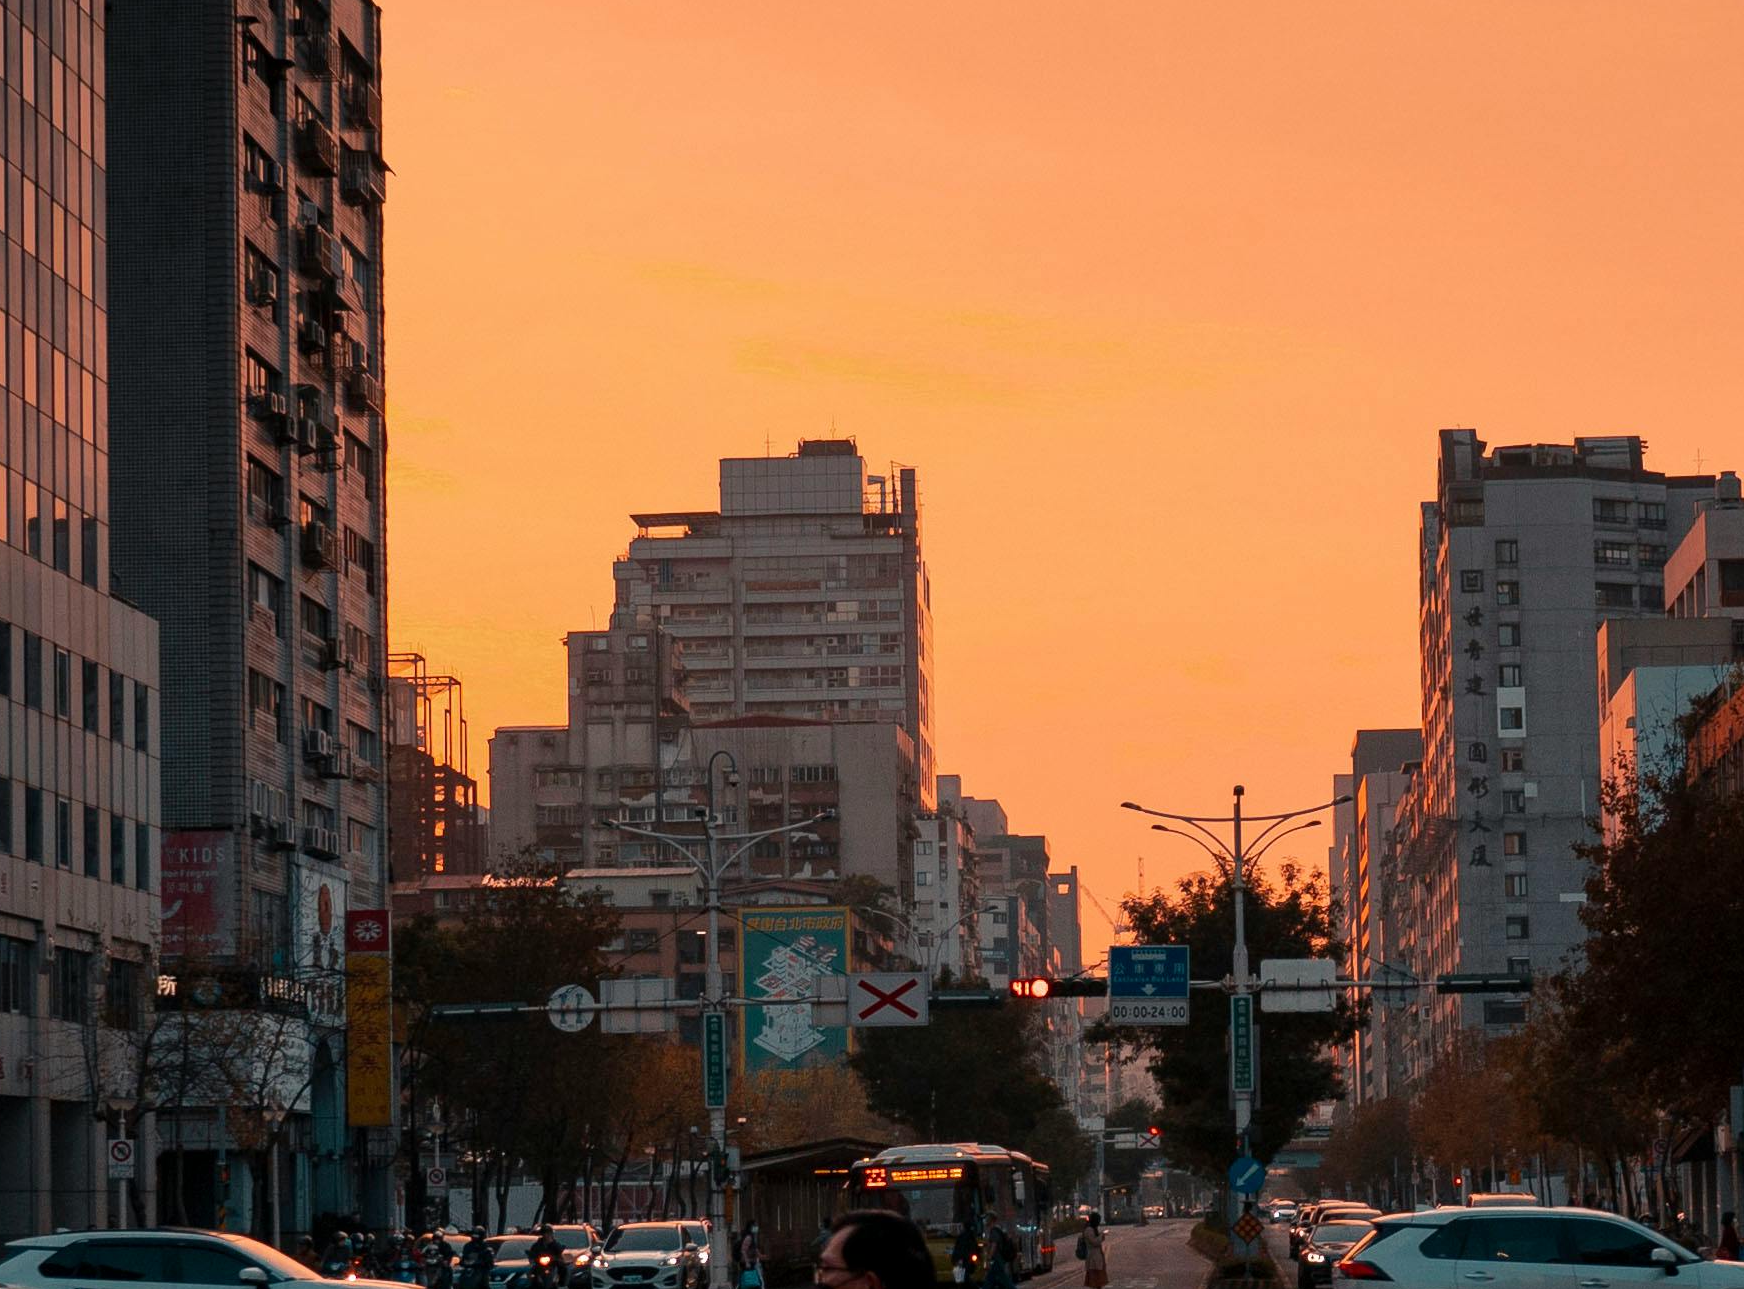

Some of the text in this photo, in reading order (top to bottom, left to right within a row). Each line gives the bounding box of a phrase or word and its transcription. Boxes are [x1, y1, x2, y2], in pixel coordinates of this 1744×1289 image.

[179, 846, 226, 864] KIDS
[1012, 981, 1030, 996] 41
[1113, 1005, 1186, 1019] 00:00-24:00
